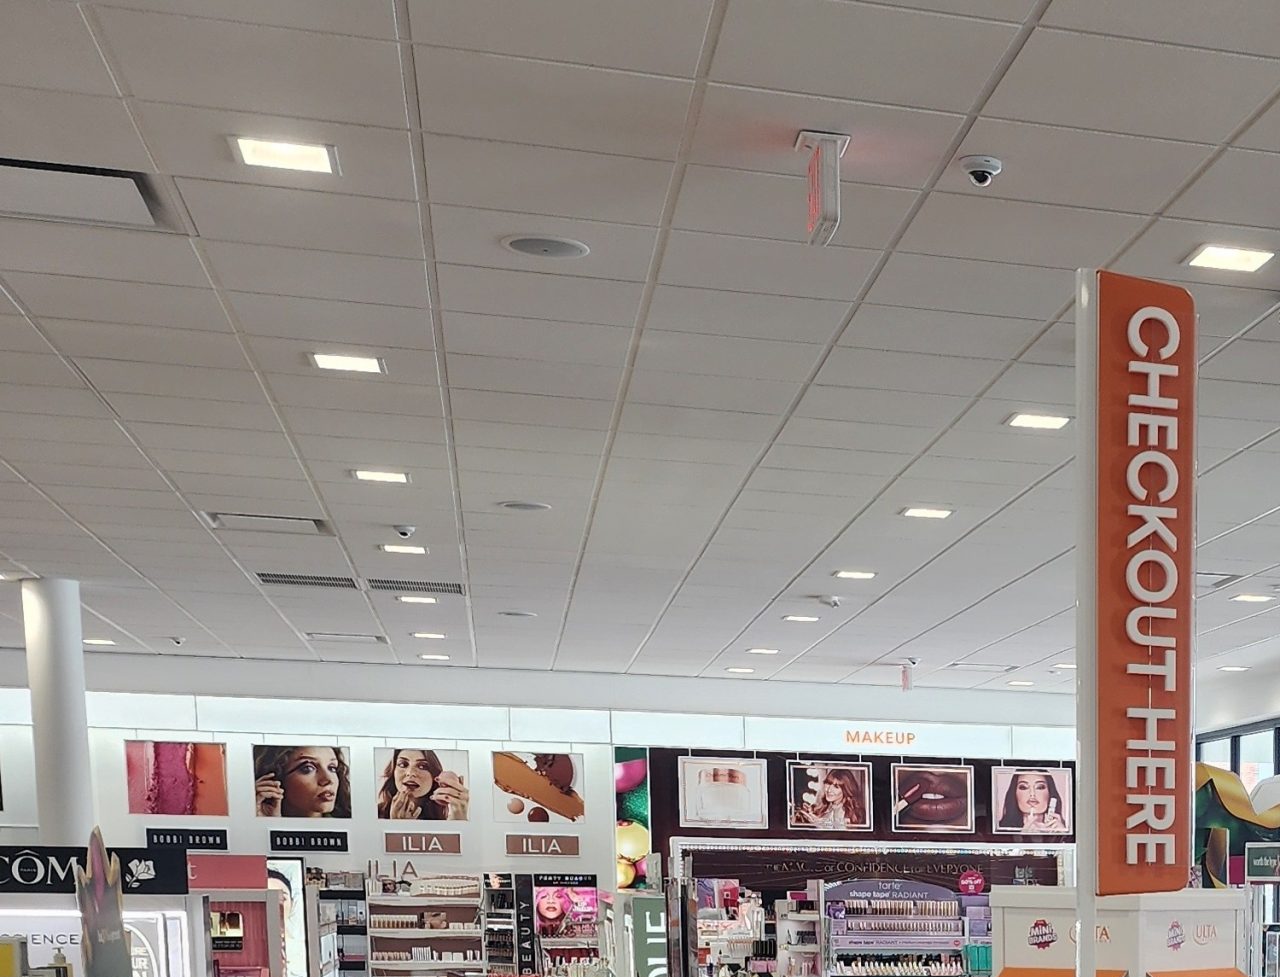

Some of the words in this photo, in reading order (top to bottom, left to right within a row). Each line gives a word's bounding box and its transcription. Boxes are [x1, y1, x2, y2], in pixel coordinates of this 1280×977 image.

[1126, 305, 1180, 692] CHECKOUT
[845, 730, 916, 744] MAKEUP
[1125, 707, 1176, 866] HERE
[153, 834, 182, 844] BOBBI
[189, 835, 221, 845] BROWN
[276, 836, 305, 846] BOBBI
[311, 838, 342, 847] BROWN
[402, 836, 443, 851] ILIA
[523, 838, 562, 853] ILIA
[367, 859, 418, 879] ILIA
[850, 891, 870, 899] shape
[872, 890, 890, 899] tape
[892, 891, 928, 899] RADIANT
[519, 901, 532, 975] BEAUTY
[1195, 924, 1217, 938] ULTA
